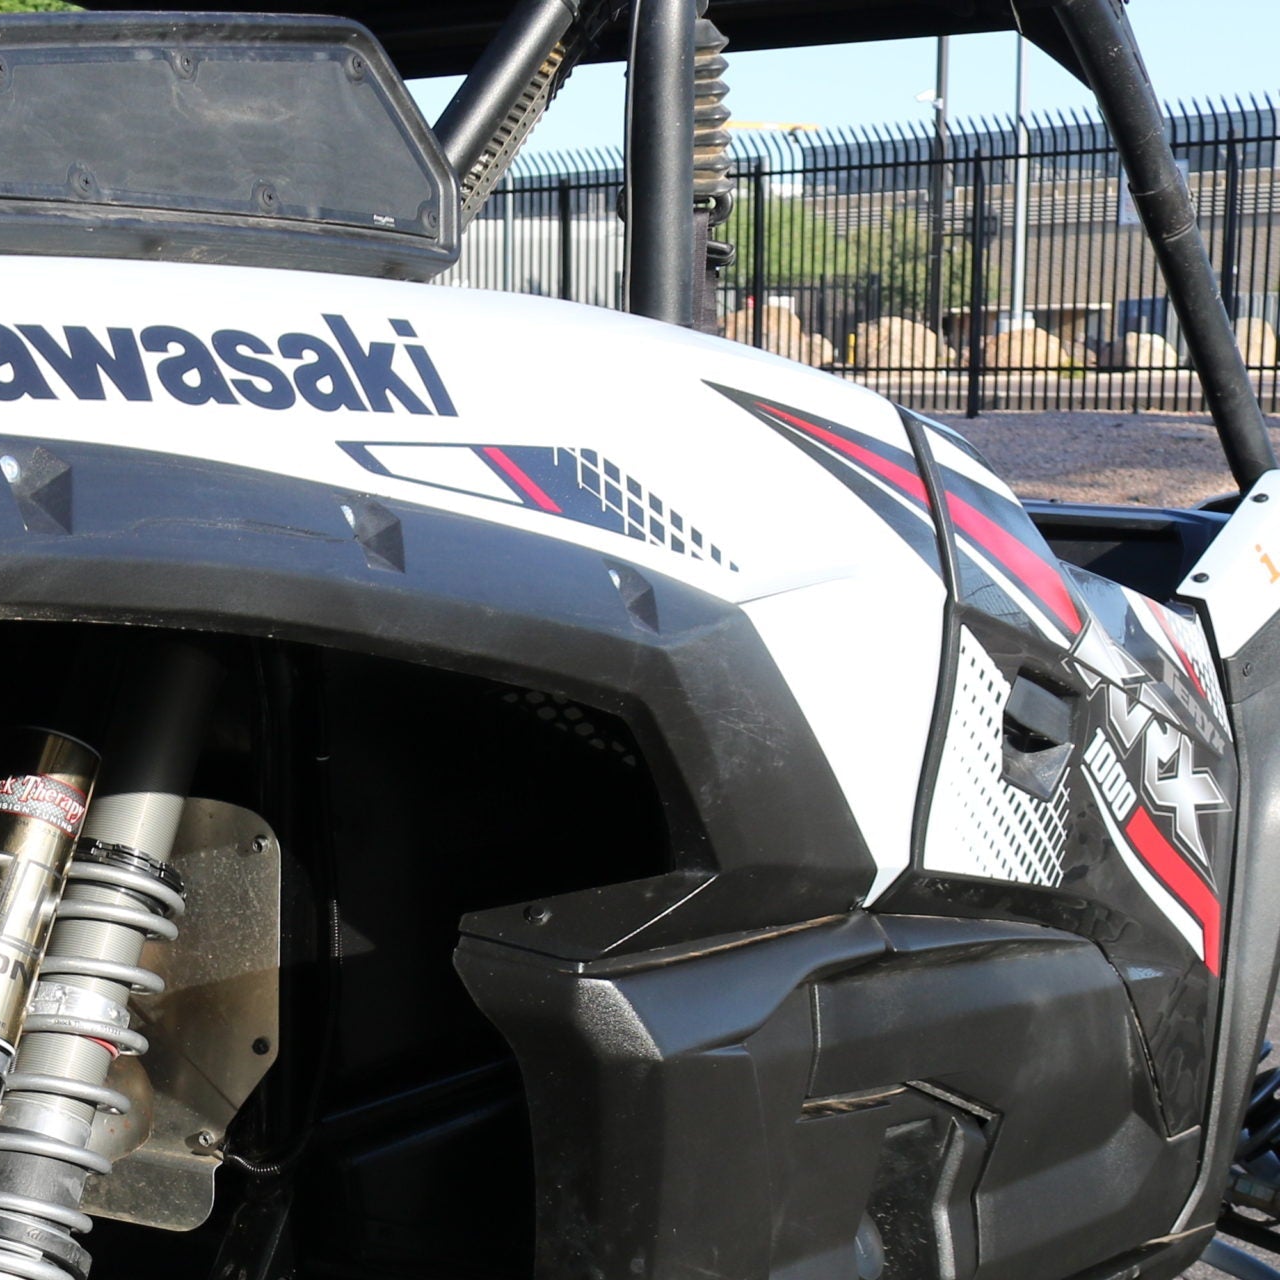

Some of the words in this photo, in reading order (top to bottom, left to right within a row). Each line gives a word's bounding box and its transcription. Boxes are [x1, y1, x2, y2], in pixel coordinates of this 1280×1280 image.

[1083, 728, 1137, 821] 1000
[19, 775, 86, 823] Therapy
[36, 809, 73, 833] TUNING
